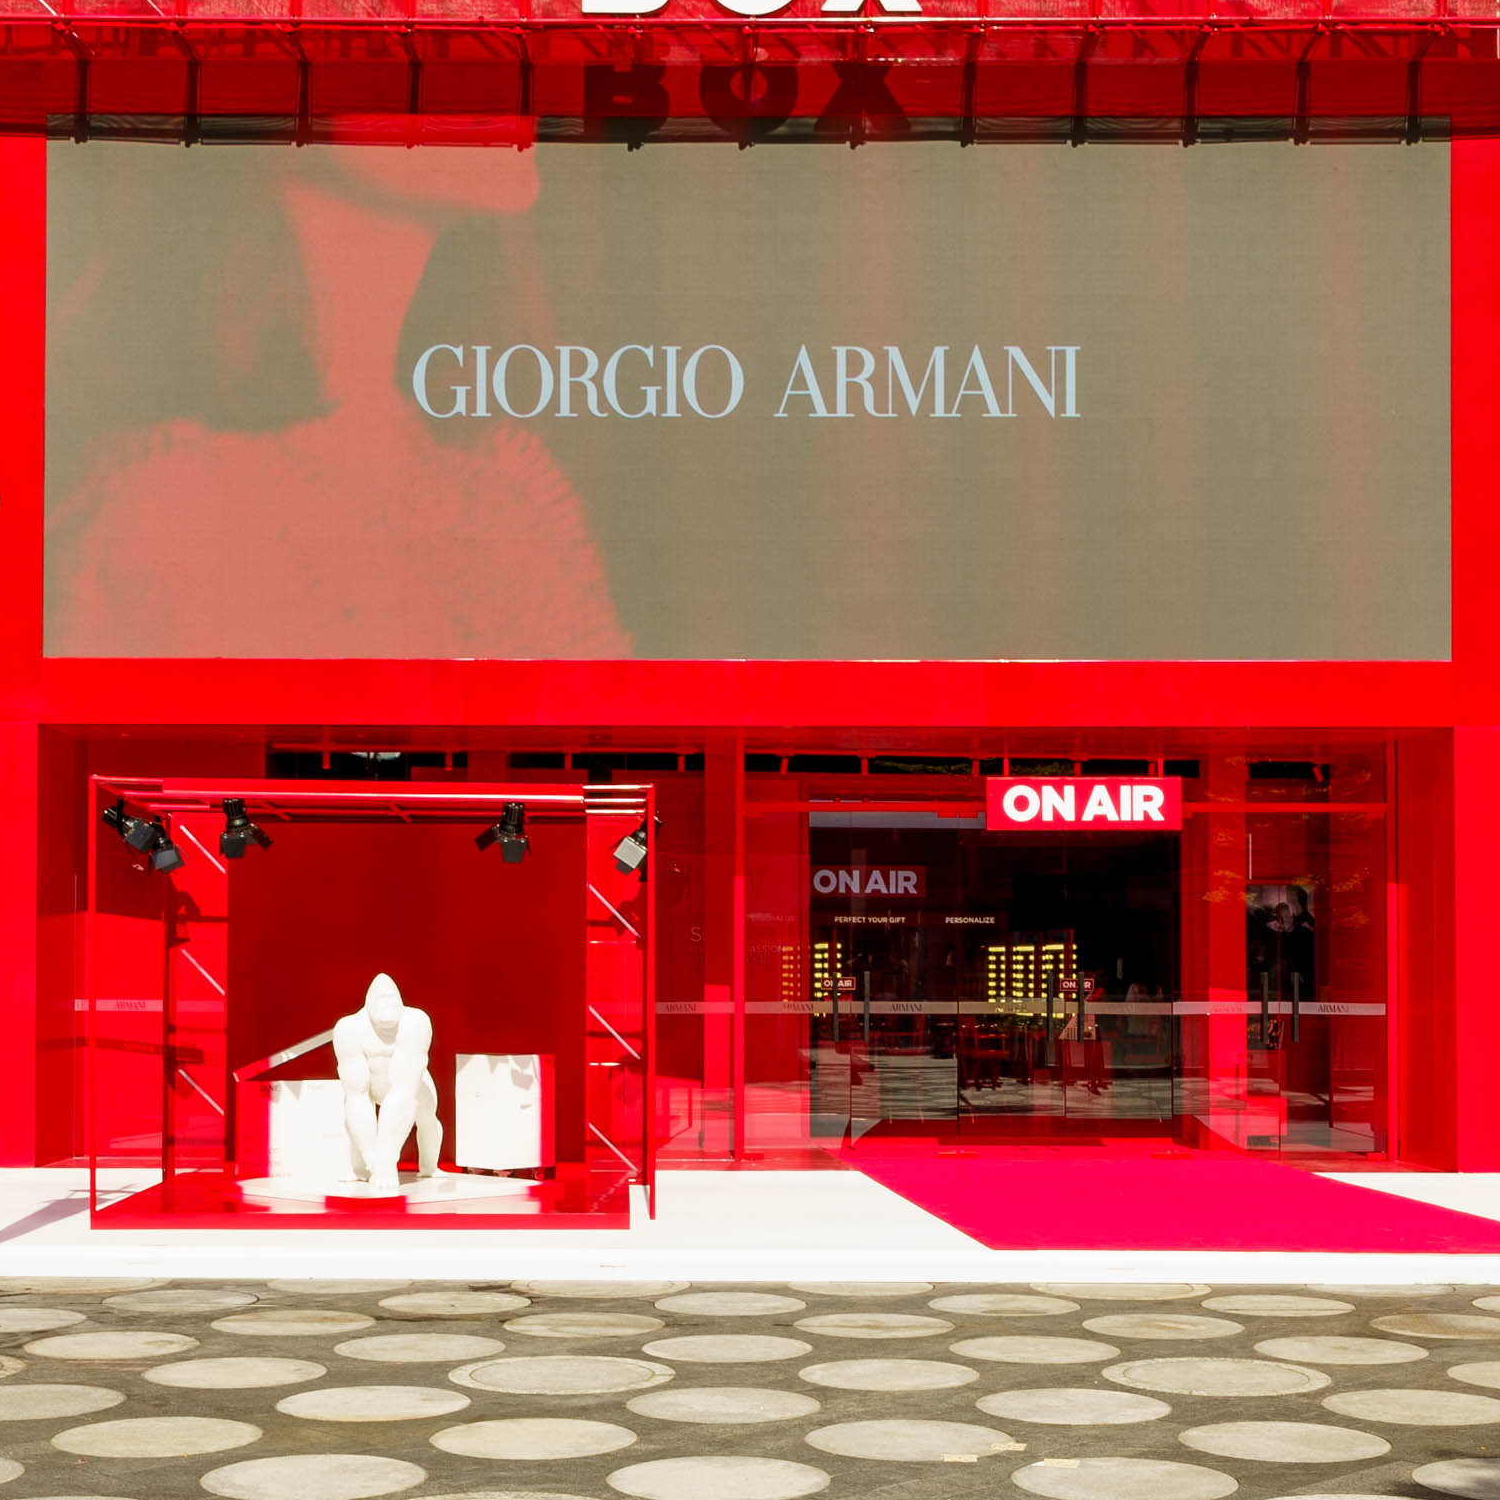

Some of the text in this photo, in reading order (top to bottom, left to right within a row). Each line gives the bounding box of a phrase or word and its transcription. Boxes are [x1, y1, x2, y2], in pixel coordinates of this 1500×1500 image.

[411, 344, 1081, 419] GIORGIO ARMANI
[1002, 784, 1165, 822] ON AIR
[813, 869, 918, 894] ON AIR
[834, 916, 906, 924] PERFECT YOUR GIFT
[945, 916, 995, 924] PERSONALIZE
